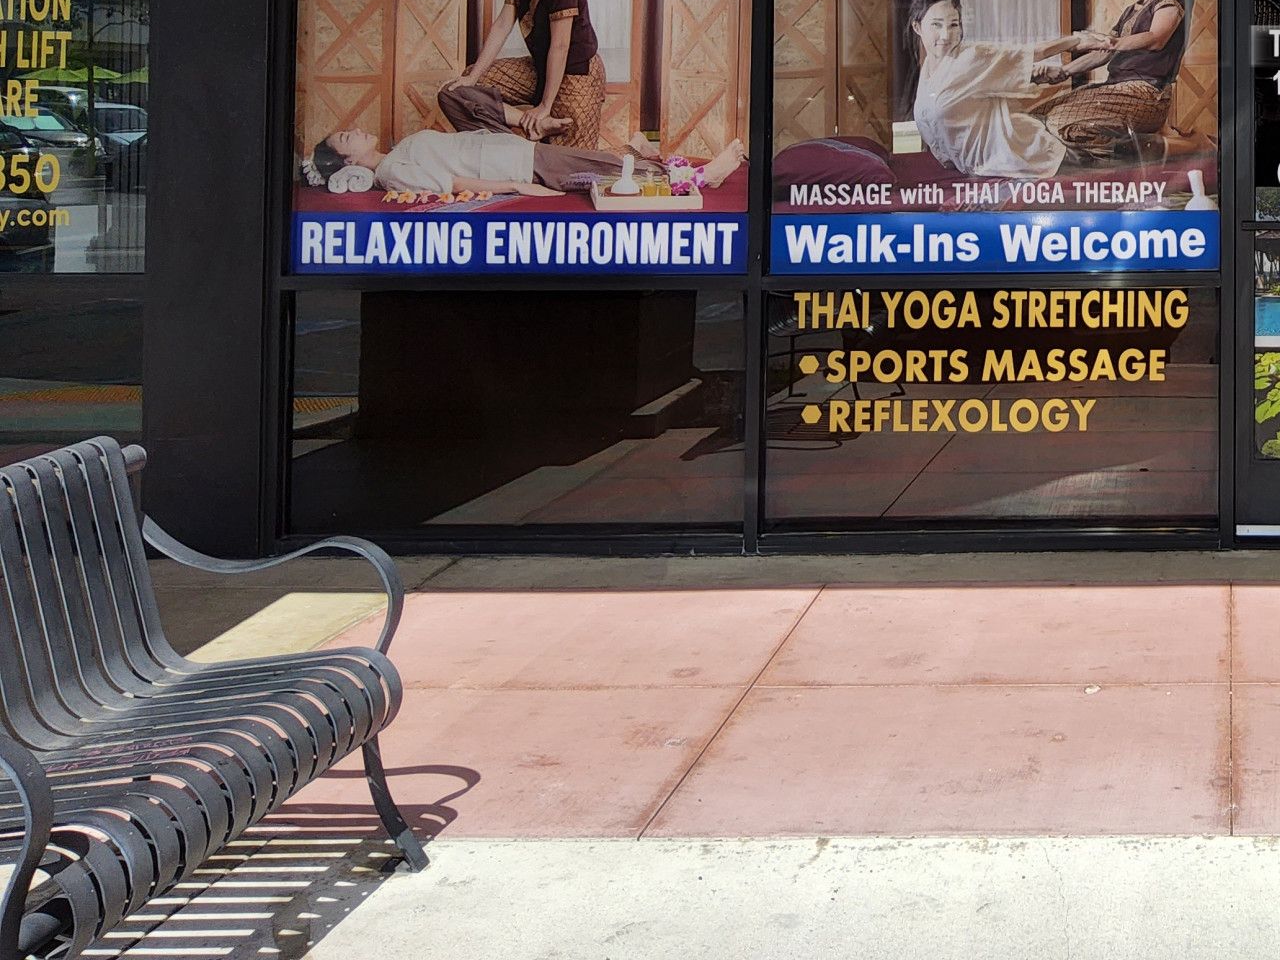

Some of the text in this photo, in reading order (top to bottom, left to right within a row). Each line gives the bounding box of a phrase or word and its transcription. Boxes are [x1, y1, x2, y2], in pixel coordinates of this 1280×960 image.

[16, 30, 72, 69] LIFT
[790, 181, 1167, 206] MASSAGE with THAI YOGA THERAPY
[300, 221, 739, 265] RELAXING ENVIRONMENT
[785, 224, 1206, 264] Walk-Ins Welcome
[794, 289, 1190, 329] THAI YOGA STRETCHING
[826, 349, 1166, 383] SPORTS MASSAGE
[829, 398, 1097, 433] REFLEXOLOGY
